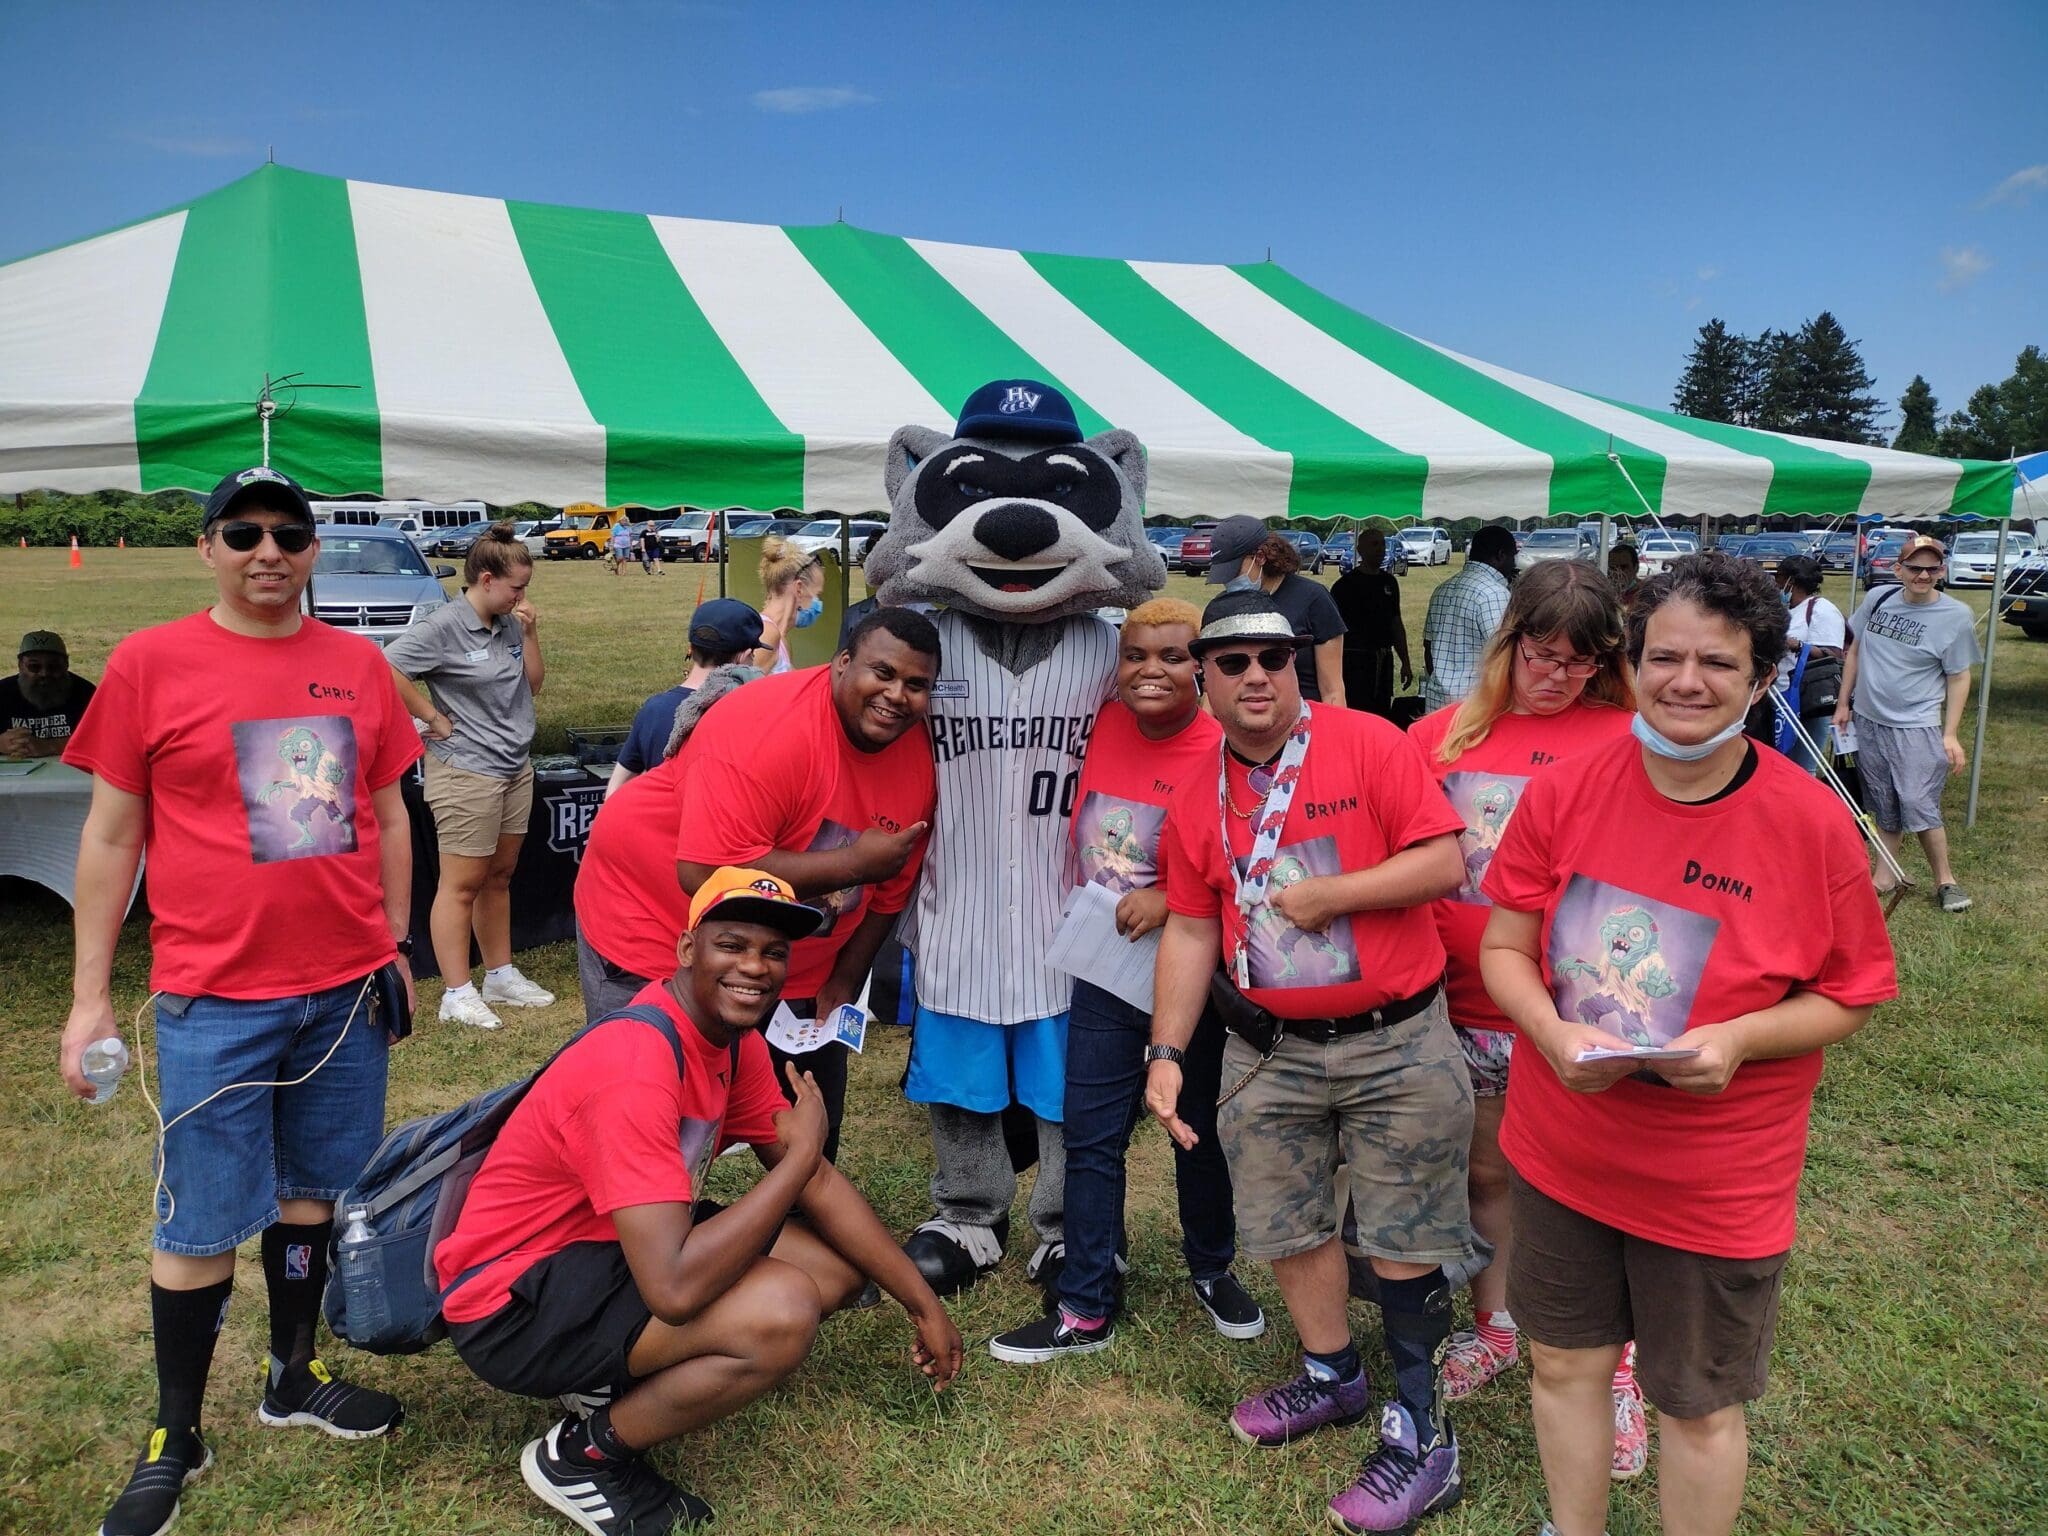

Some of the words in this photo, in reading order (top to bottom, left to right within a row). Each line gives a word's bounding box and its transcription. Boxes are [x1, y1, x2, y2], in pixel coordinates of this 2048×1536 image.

[1888, 614, 1927, 639] PEOPLE
[308, 682, 356, 701] CHRIS
[929, 713, 1094, 763] RENEGADES
[1152, 779, 1176, 796] TIFF
[558, 802, 604, 841] RE
[1304, 796, 1358, 820] BRYAN
[1682, 859, 1753, 904] DONNA
[1380, 1404, 1402, 1441] 23
